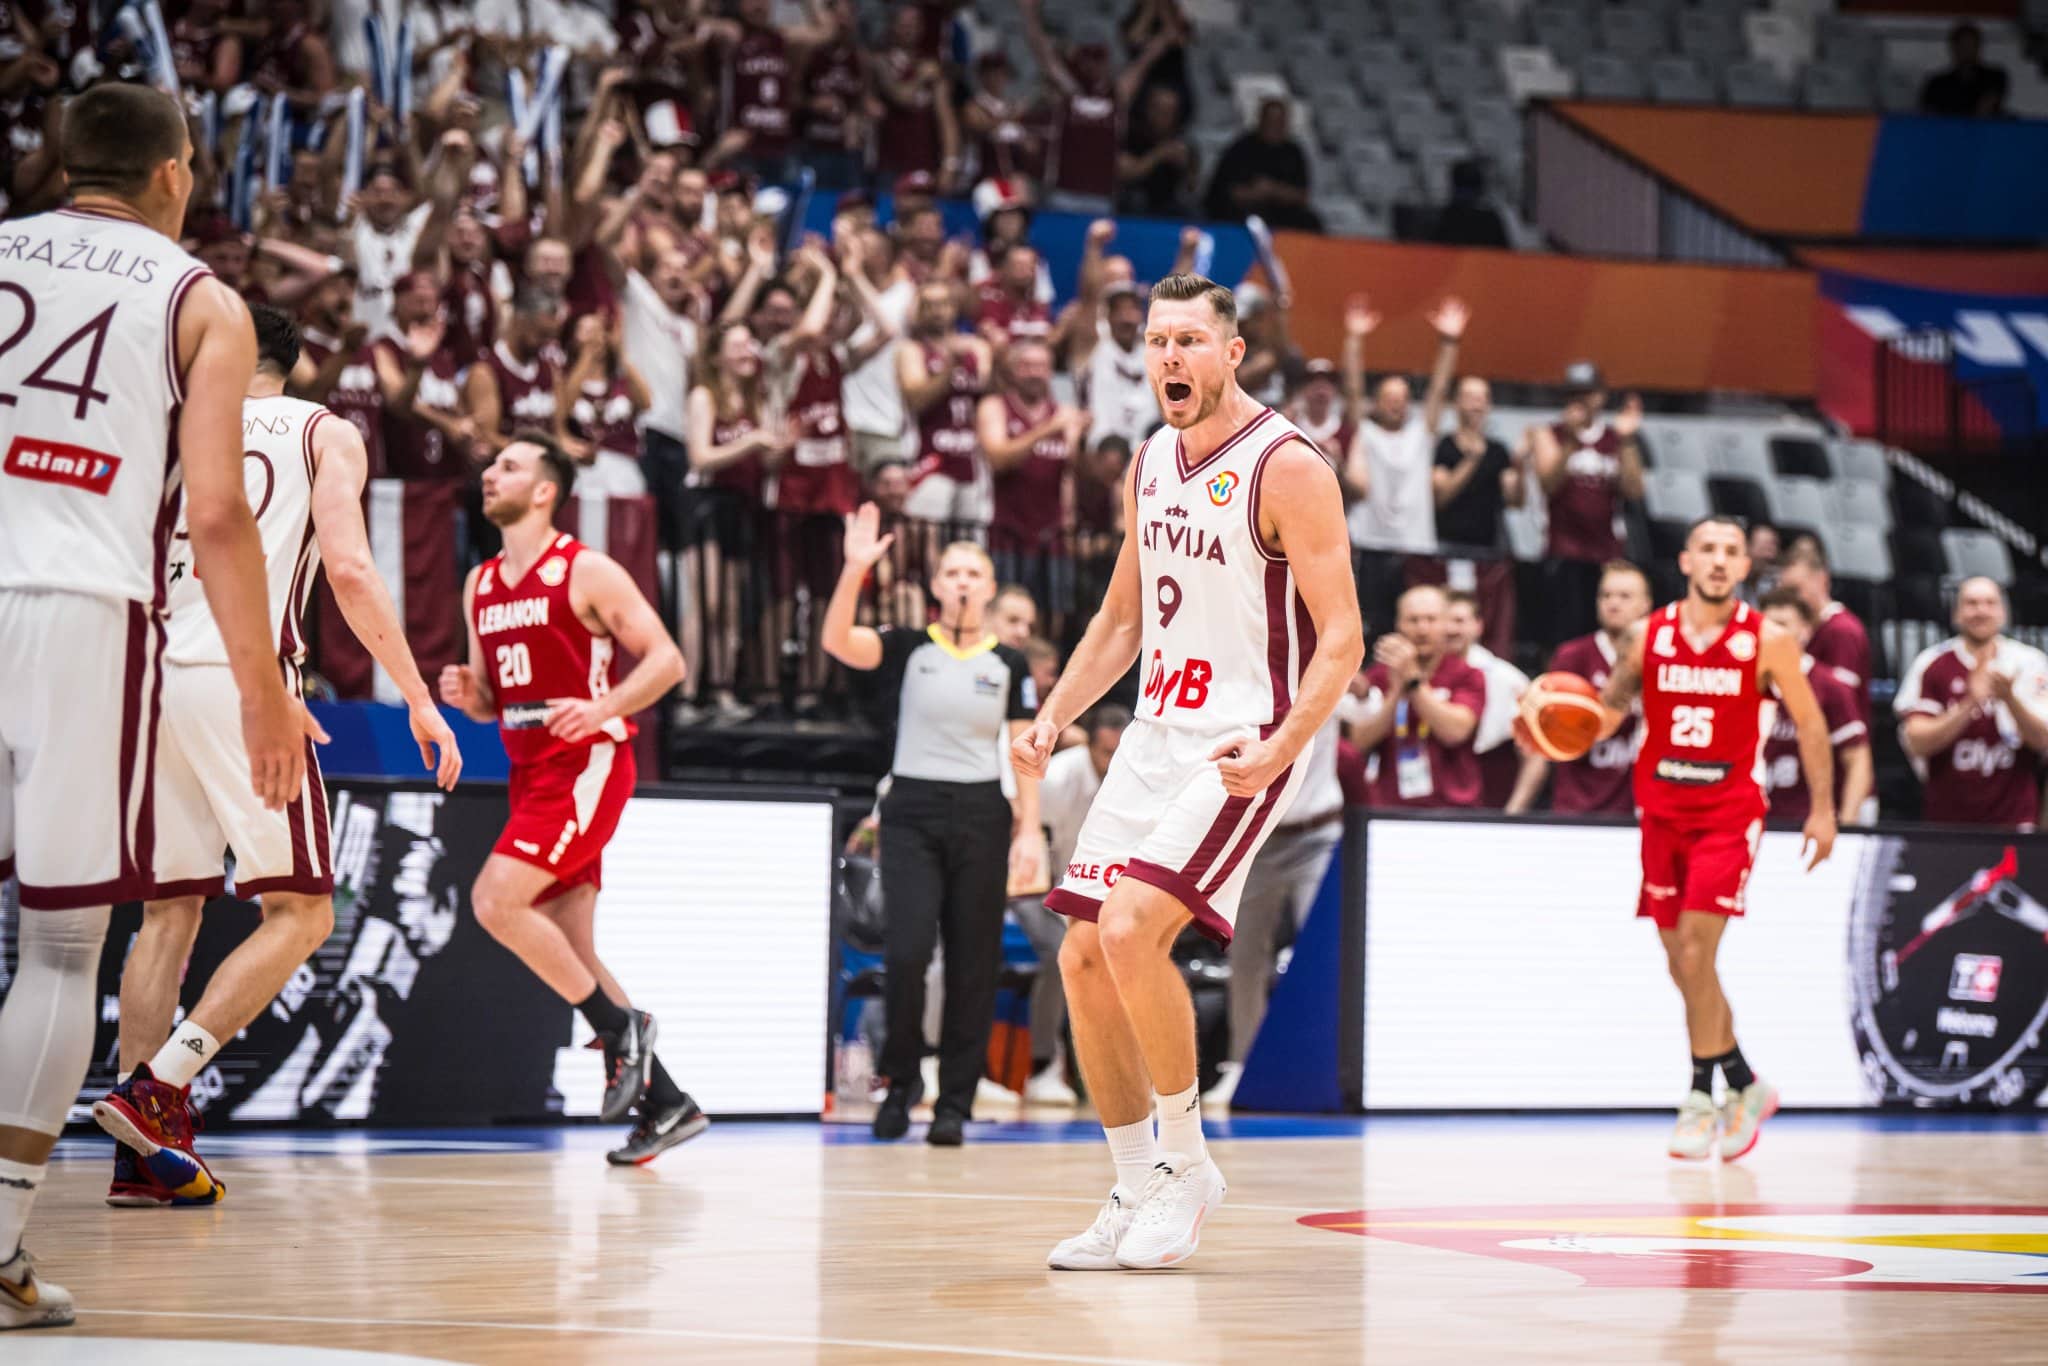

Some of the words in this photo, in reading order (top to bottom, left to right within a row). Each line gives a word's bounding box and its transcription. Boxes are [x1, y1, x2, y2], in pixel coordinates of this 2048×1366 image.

[1143, 520, 1226, 565] ATVIJA
[478, 597, 549, 636] LEBANON
[1157, 575, 1182, 629] 9
[496, 642, 532, 688] 20
[1657, 664, 1742, 697] LEBANON
[1670, 705, 1714, 748] 25
